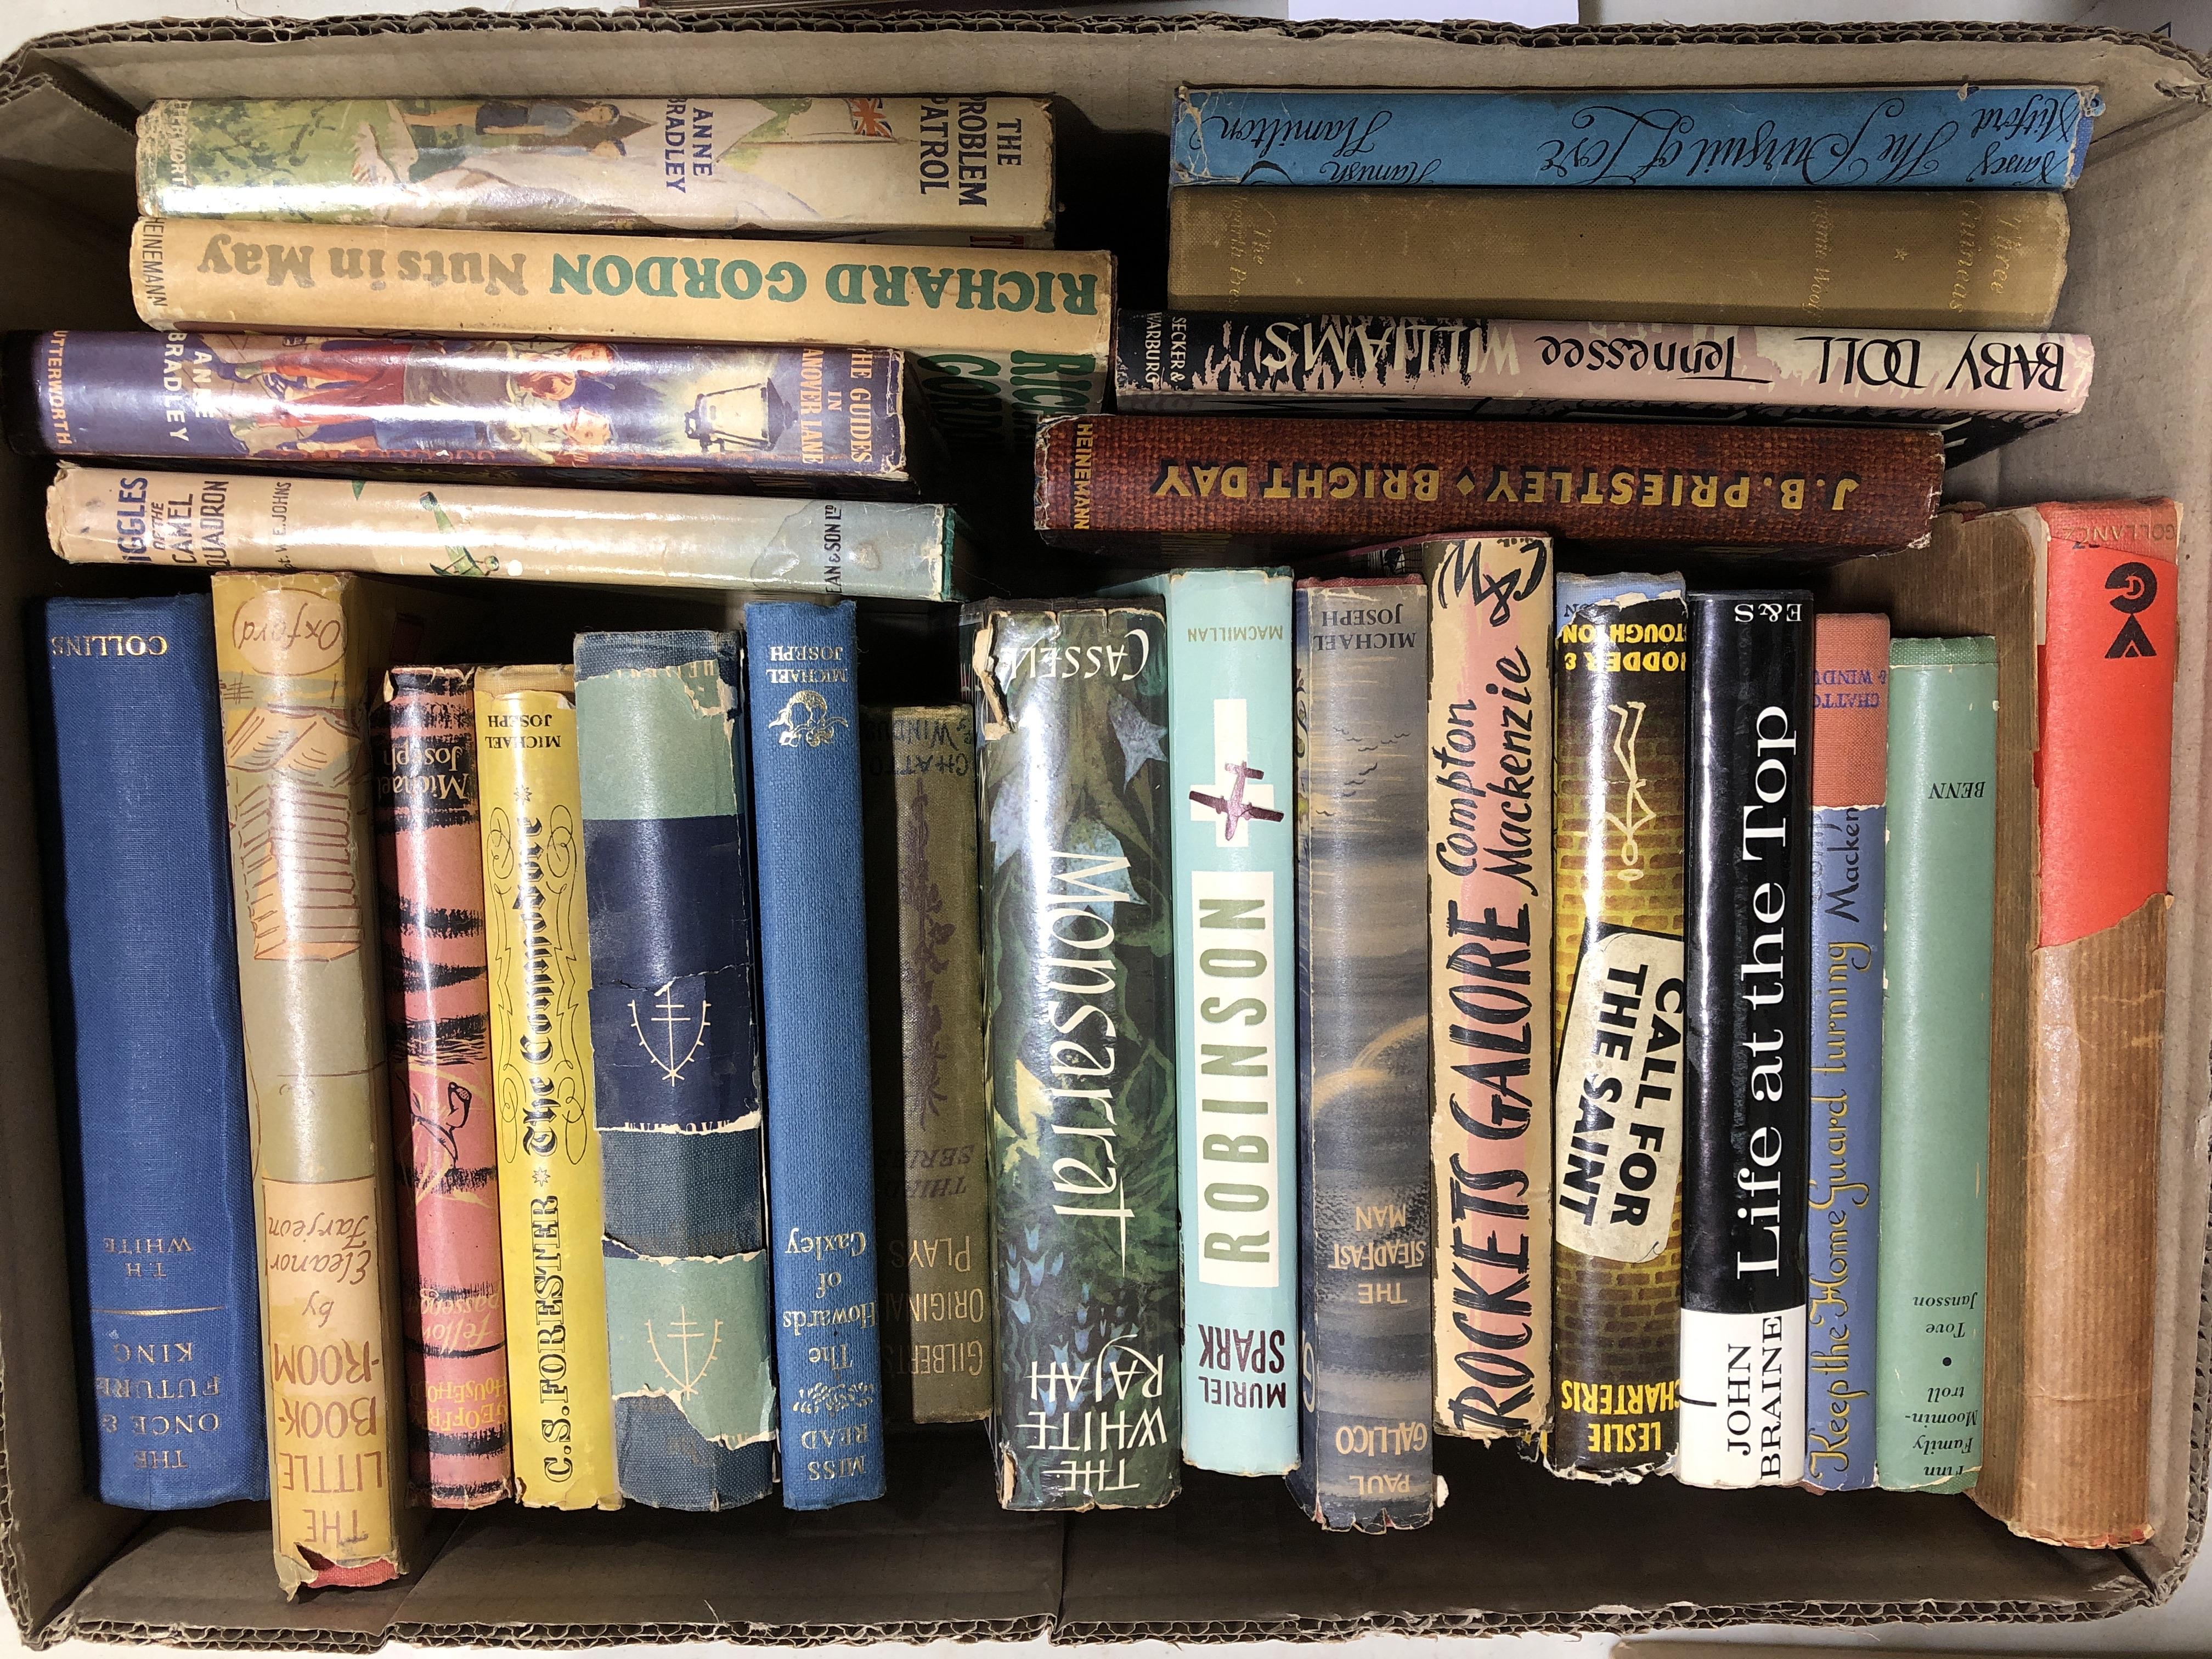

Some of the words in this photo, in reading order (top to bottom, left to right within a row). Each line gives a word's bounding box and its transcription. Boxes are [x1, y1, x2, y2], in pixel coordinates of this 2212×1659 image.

[693, 108, 713, 176] ANNE
[997, 118, 1022, 166] THE
[1189, 110, 1392, 157] Hamilton
[142, 218, 168, 307] HEINEMANN
[198, 234, 314, 289] May
[329, 248, 387, 291] in
[398, 251, 529, 296] Nuts
[549, 252, 806, 302] GORDON
[824, 261, 1098, 317] RICHARD
[1145, 312, 1162, 383] WARBURG
[1171, 317, 1187, 369] SECKER
[1261, 323, 1521, 376] WILLIAMS
[1534, 336, 1773, 384] Tennessee
[1794, 336, 1927, 388] DOLL
[1945, 334, 2067, 392] BABY
[48, 330, 72, 444] UTTERWORTH
[163, 332, 189, 441] BRADLEY
[851, 352, 873, 379] HE
[1171, 373, 1185, 382] &
[828, 391, 842, 411] IN
[800, 421, 823, 464] LANE
[849, 388, 872, 462] GUIDES
[1074, 424, 1093, 529] HEINEMANN
[1156, 466, 1248, 498] DAY
[1263, 467, 1438, 501] BRIGHT
[1487, 471, 1750, 507] PRIESTLEY
[151, 501, 164, 525] THE
[168, 493, 197, 563] CAMEL
[2062, 524, 2175, 543] GOLLANCZ
[823, 524, 841, 551] SON
[238, 603, 341, 651] Oxford
[1188, 625, 1283, 642] MACMILLAN
[1322, 603, 1403, 626] JOSEPH
[51, 635, 167, 656] COLLINS
[770, 646, 843, 661] JOSEPH
[1313, 633, 1415, 650] MICHAEL
[766, 668, 848, 683] MICHAEL
[485, 736, 561, 748] MICHAEL
[488, 714, 552, 727] JOSEPH
[1431, 699, 1487, 876] Compton
[1482, 645, 1538, 896] Mackenzie
[1742, 706, 1796, 861] Top
[1928, 782, 1985, 799] BENN
[512, 816, 555, 1064] Commodore
[1741, 882, 1785, 979] the
[1446, 900, 1532, 1140] GALORE
[1594, 964, 1648, 1062] THE
[1634, 978, 1683, 1110] CALL
[1742, 1029, 1784, 1101] at
[1048, 862, 1135, 1276] Monsarrat
[1199, 899, 1269, 1262] ROBINSON
[523, 1077, 561, 1156] The
[1560, 1074, 1622, 1226] SAINT
[1807, 1089, 1869, 1210] Guard
[1610, 1124, 1664, 1228] FOR
[1356, 1205, 1406, 1230] MAN
[1737, 1126, 1782, 1280] Life
[103, 1238, 193, 1254] WHITE
[269, 1212, 369, 1250] Farjeon
[785, 1228, 866, 1261] Caxley
[270, 1250, 371, 1285] Eleanor
[1328, 1242, 1425, 1270] STEADFAST
[1809, 1209, 1848, 1326] Home
[531, 1195, 568, 1404] FORESTER
[816, 1272, 841, 1299] of
[1358, 1284, 1407, 1304] THE
[1448, 1154, 1535, 1429] ROCKETS
[1912, 1293, 1977, 1310] Jansson
[302, 1290, 334, 1328] by
[783, 1302, 875, 1336] Howards
[1925, 1322, 1965, 1338] Tove
[114, 1342, 193, 1363] KING
[809, 1344, 852, 1370] The
[1024, 1334, 1164, 1402] RAJAH
[1198, 1324, 1284, 1373] SPARK
[1810, 1324, 1848, 1375] the
[95, 1375, 219, 1399] FUTURE
[1198, 1376, 1285, 1408] MURIEL
[1727, 1344, 1752, 1457] JOHN
[1761, 1316, 1783, 1479] BRAINE
[1927, 1386, 1964, 1403] troll
[132, 1413, 219, 1435] ONCE
[801, 1424, 868, 1449] READ
[1015, 1406, 1167, 1452] WHITE
[1335, 1422, 1427, 1457] GALLICO
[1589, 1421, 1661, 1452] LESLIE
[1809, 1379, 1869, 1479] Keep
[1904, 1412, 1977, 1429] Moomin-
[133, 1449, 188, 1469] THE
[808, 1455, 866, 1480] MISS
[1911, 1437, 1973, 1457] Family
[279, 1451, 382, 1493] LITTLE
[1041, 1458, 1140, 1497] THE
[1349, 1474, 1410, 1496] PAUL
[302, 1509, 369, 1543] THE
